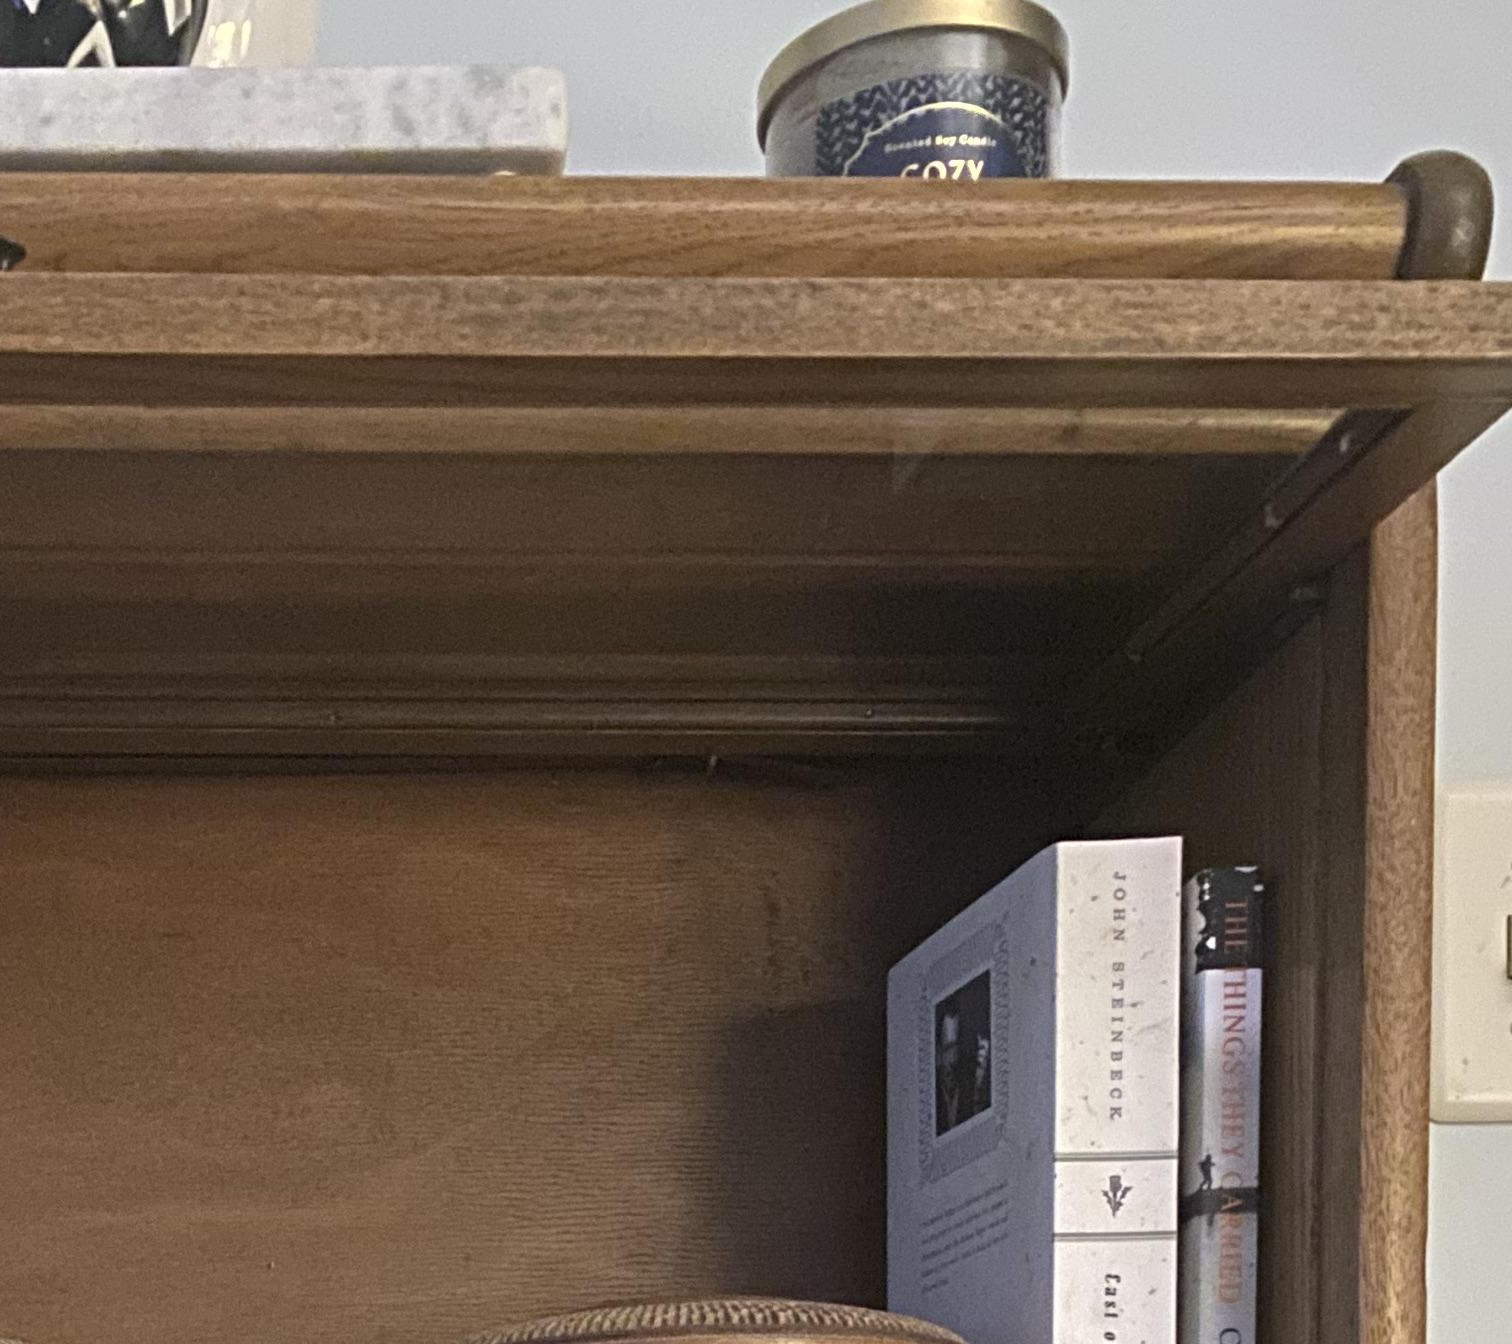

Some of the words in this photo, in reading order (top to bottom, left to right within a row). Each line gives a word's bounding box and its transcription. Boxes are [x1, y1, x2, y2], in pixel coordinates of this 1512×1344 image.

[1113, 871, 1127, 942] JOHN
[1223, 901, 1248, 952] THE
[1109, 962, 1126, 1120] STEINBECK
[1221, 970, 1247, 1081] THINGS
[1220, 1087, 1245, 1158] THEY
[1219, 1172, 1244, 1305] CARRIED
[1104, 1273, 1121, 1320] East
